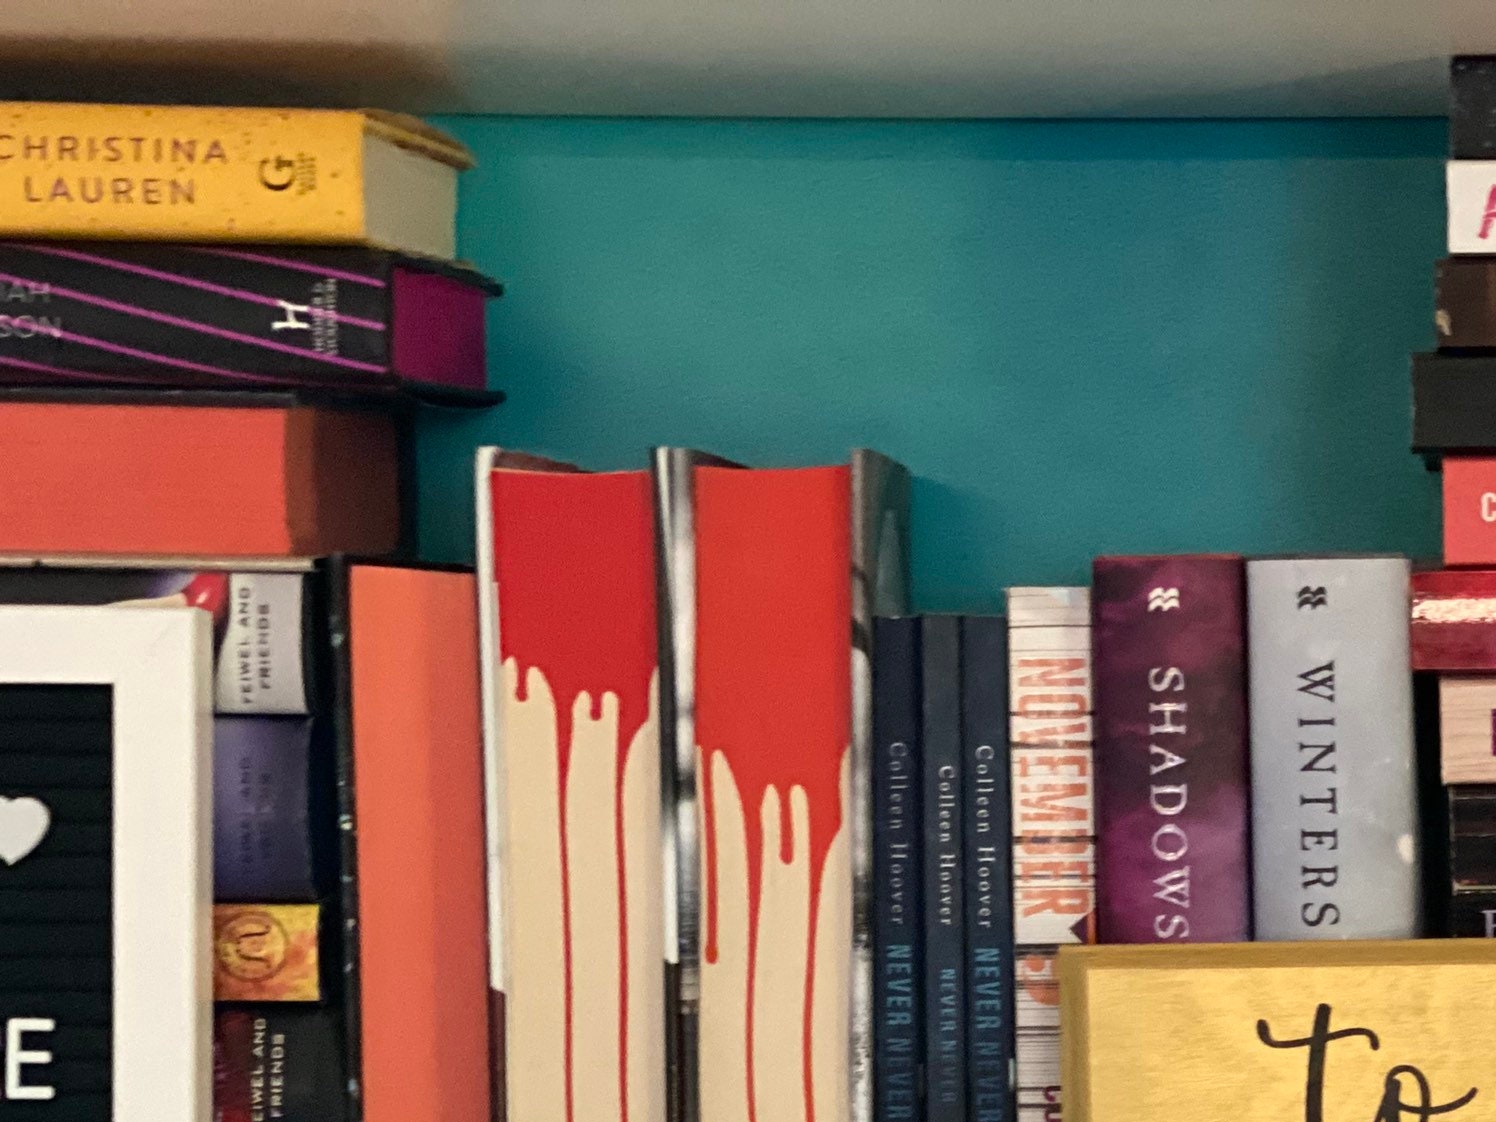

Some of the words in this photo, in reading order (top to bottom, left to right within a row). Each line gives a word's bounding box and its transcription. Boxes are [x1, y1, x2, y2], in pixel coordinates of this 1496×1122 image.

[24, 176, 197, 205] LAUREN
[888, 742, 909, 830] Colleen
[937, 765, 956, 842] Colleen
[974, 745, 995, 833] Colleen
[1015, 657, 1096, 919] NOVEMBER
[1147, 666, 1191, 940] SHADOWS
[1296, 660, 1341, 928] WINTERS
[889, 843, 909, 925] Hoover
[938, 854, 957, 926] Hoover
[977, 847, 997, 929] Hoover
[886, 944, 913, 1026] NEVER
[973, 947, 1002, 1030] NEVER
[252, 1018, 267, 1057] AND
[270, 1033, 286, 1118] FRIENDS
